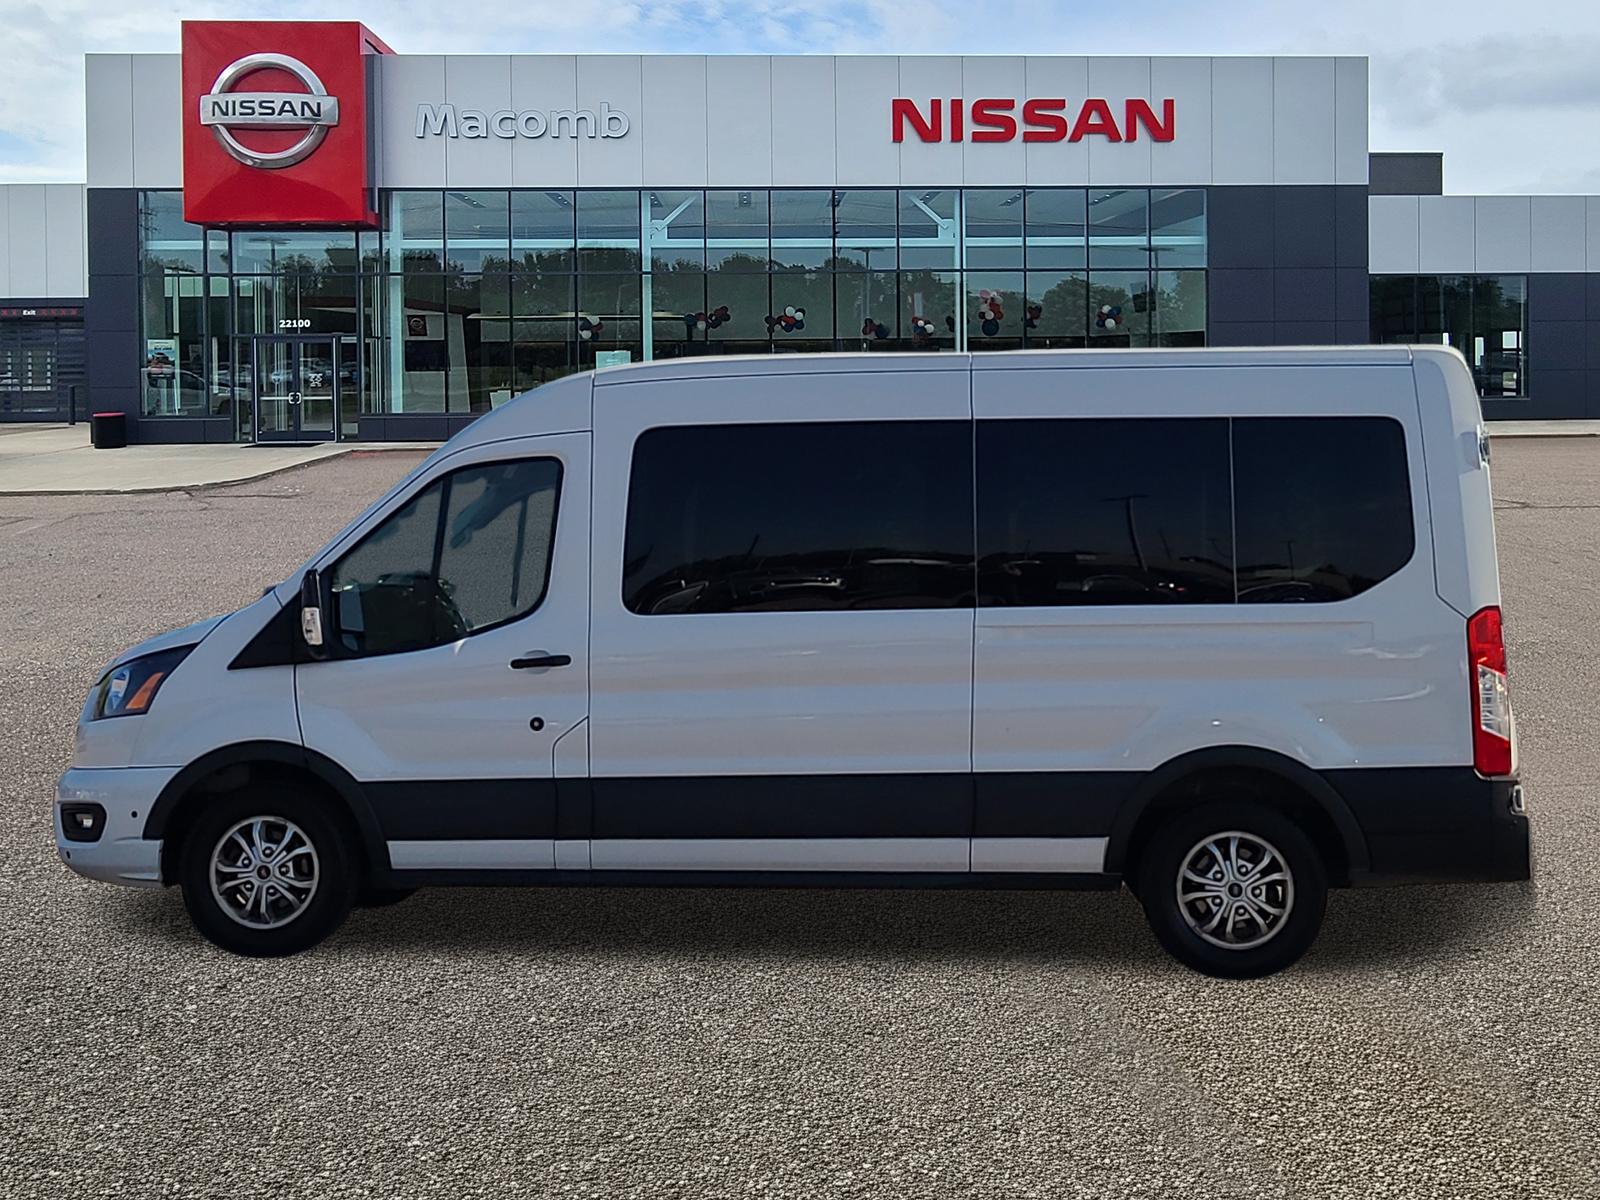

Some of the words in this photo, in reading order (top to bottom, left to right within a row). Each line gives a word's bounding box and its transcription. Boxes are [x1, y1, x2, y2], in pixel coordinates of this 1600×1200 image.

[211, 100, 322, 117] NISSAN
[415, 102, 630, 138] Macomb
[891, 98, 1175, 143] NISSAN
[279, 319, 311, 328] 22100
